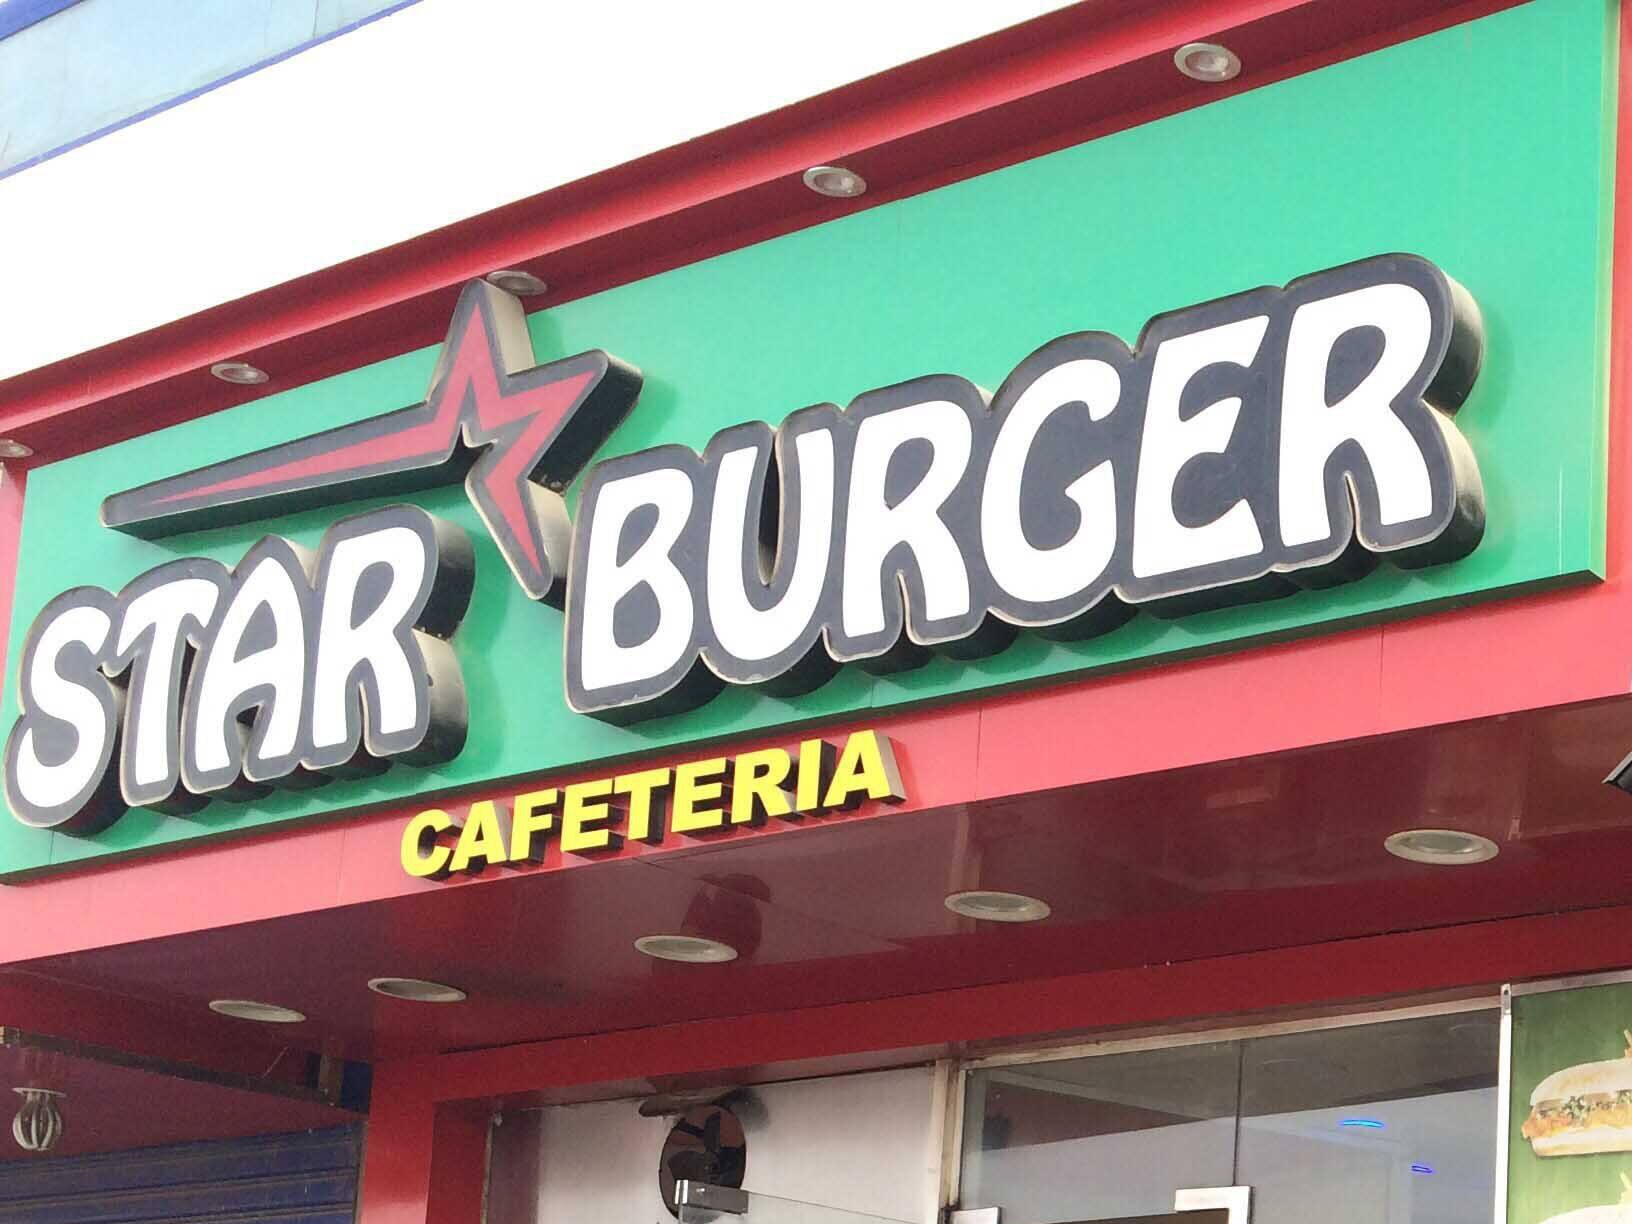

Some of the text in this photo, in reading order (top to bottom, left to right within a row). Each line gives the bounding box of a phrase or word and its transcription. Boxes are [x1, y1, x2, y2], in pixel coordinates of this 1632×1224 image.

[6, 258, 1456, 826] STAR BURGER
[400, 730, 892, 878] CAFETERIA
